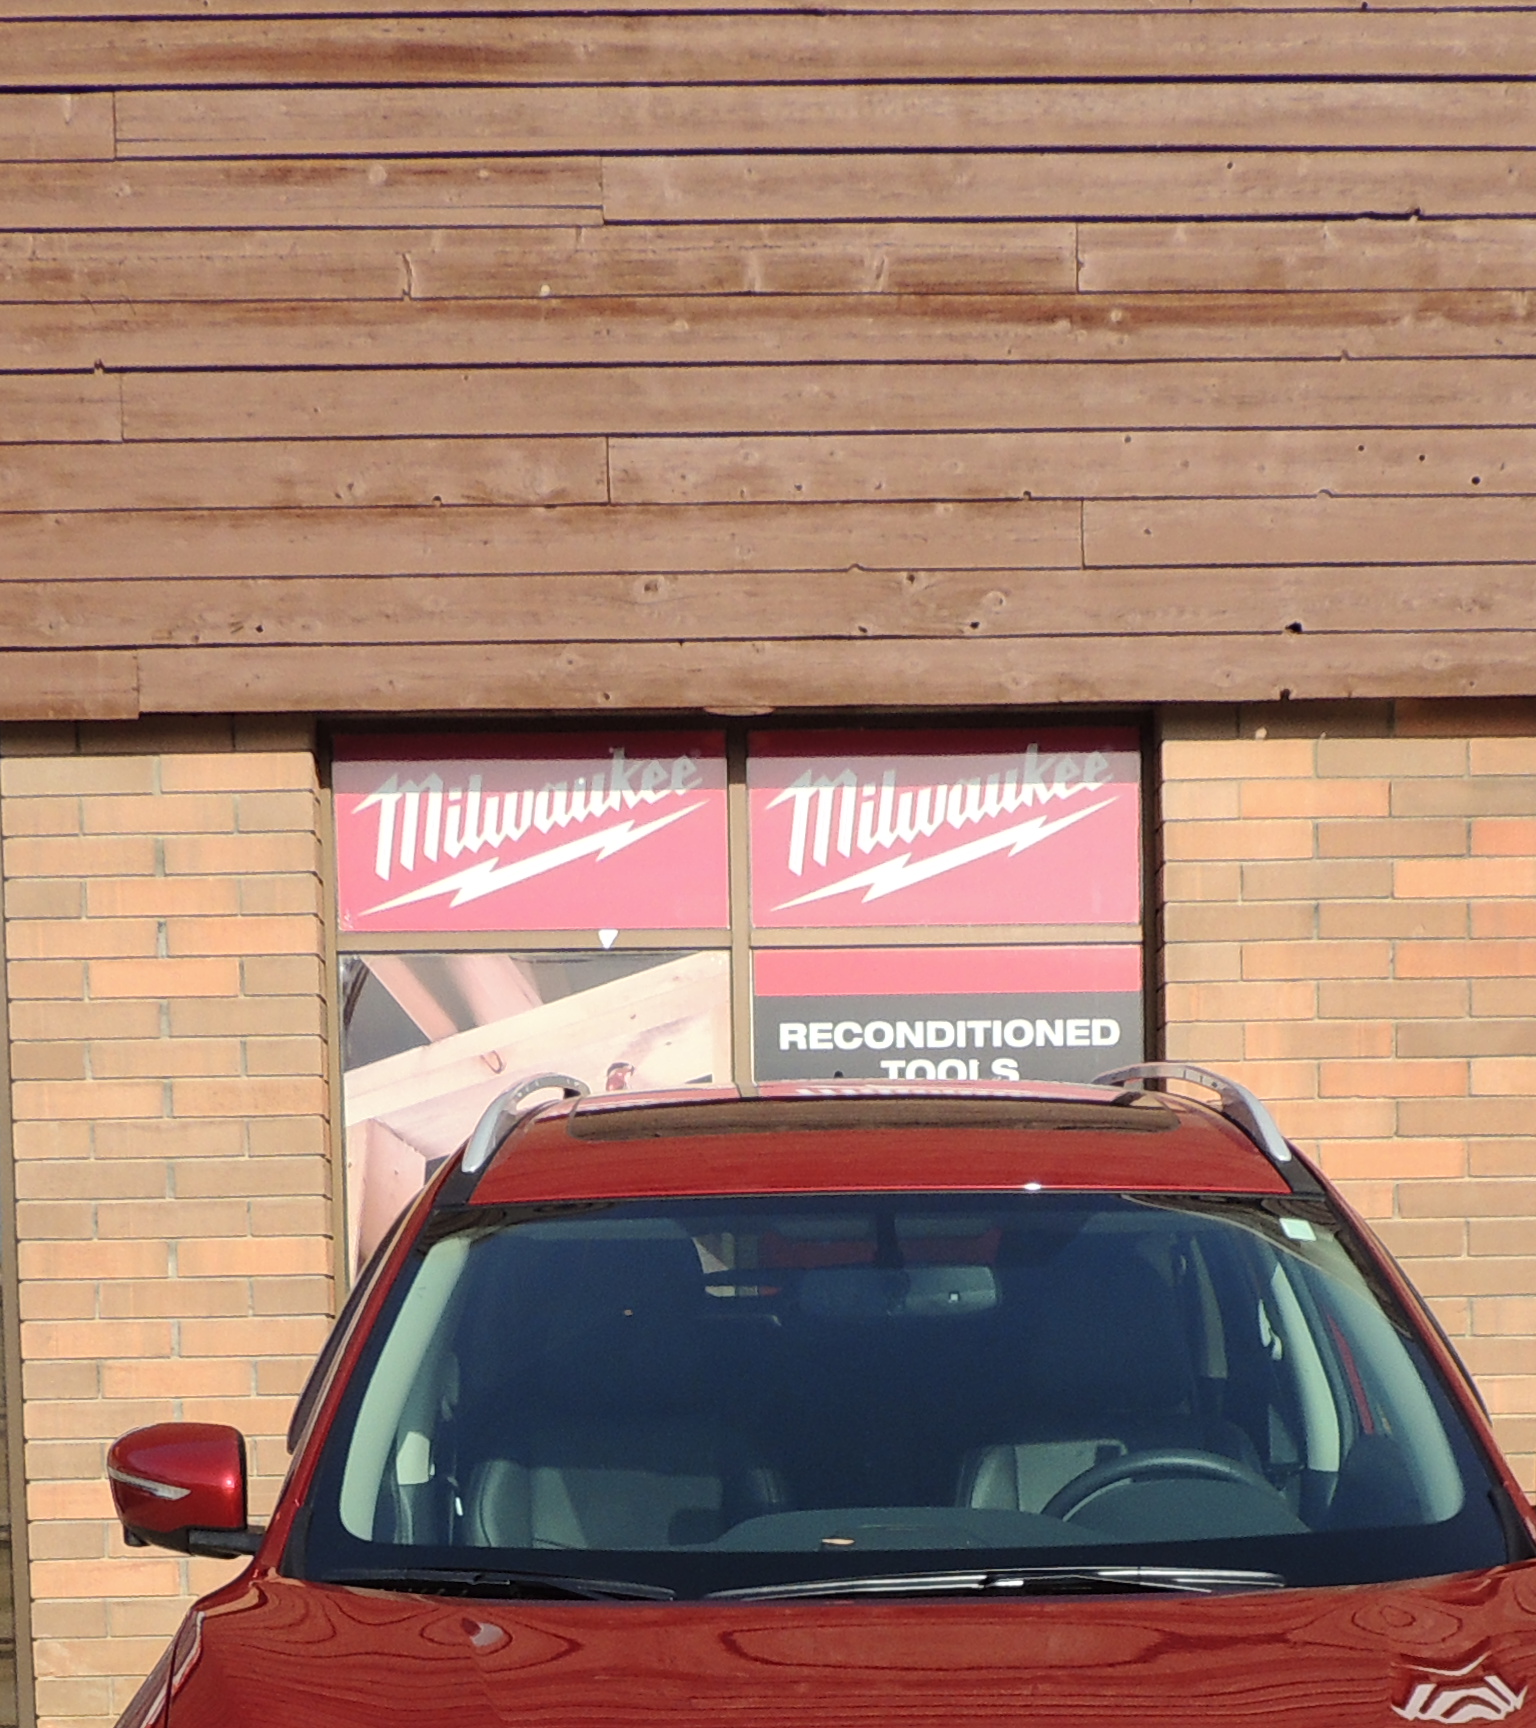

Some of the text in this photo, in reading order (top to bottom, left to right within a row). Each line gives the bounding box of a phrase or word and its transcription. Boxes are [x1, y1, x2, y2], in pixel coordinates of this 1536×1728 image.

[351, 747, 703, 881] Milwaukee
[765, 743, 1113, 876] Milwaukee
[779, 1018, 1121, 1050] RECONDITIONED
